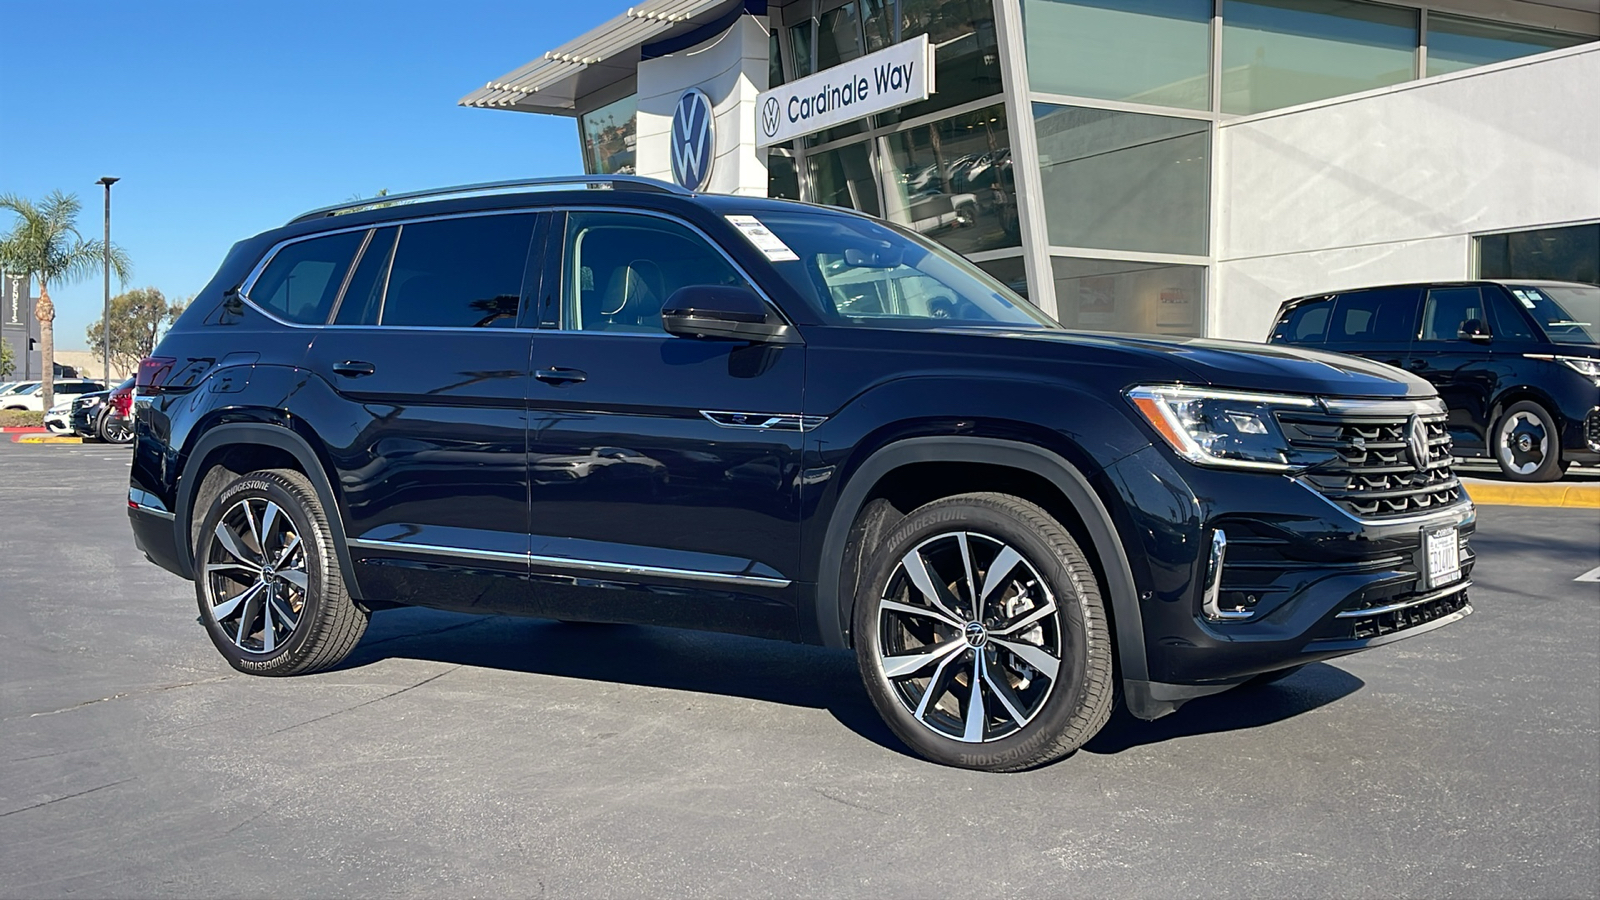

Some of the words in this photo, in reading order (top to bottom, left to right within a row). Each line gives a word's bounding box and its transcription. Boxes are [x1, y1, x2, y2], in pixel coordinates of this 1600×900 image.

[787, 74, 869, 123] Cardinale
[874, 61, 914, 95] Way
[220, 479, 270, 505] BRIDGESTONE
[886, 508, 968, 553] BRIDGESTONE
[240, 649, 292, 671] BRIDGESTONE
[959, 726, 1051, 766] BRIDGESTONE
